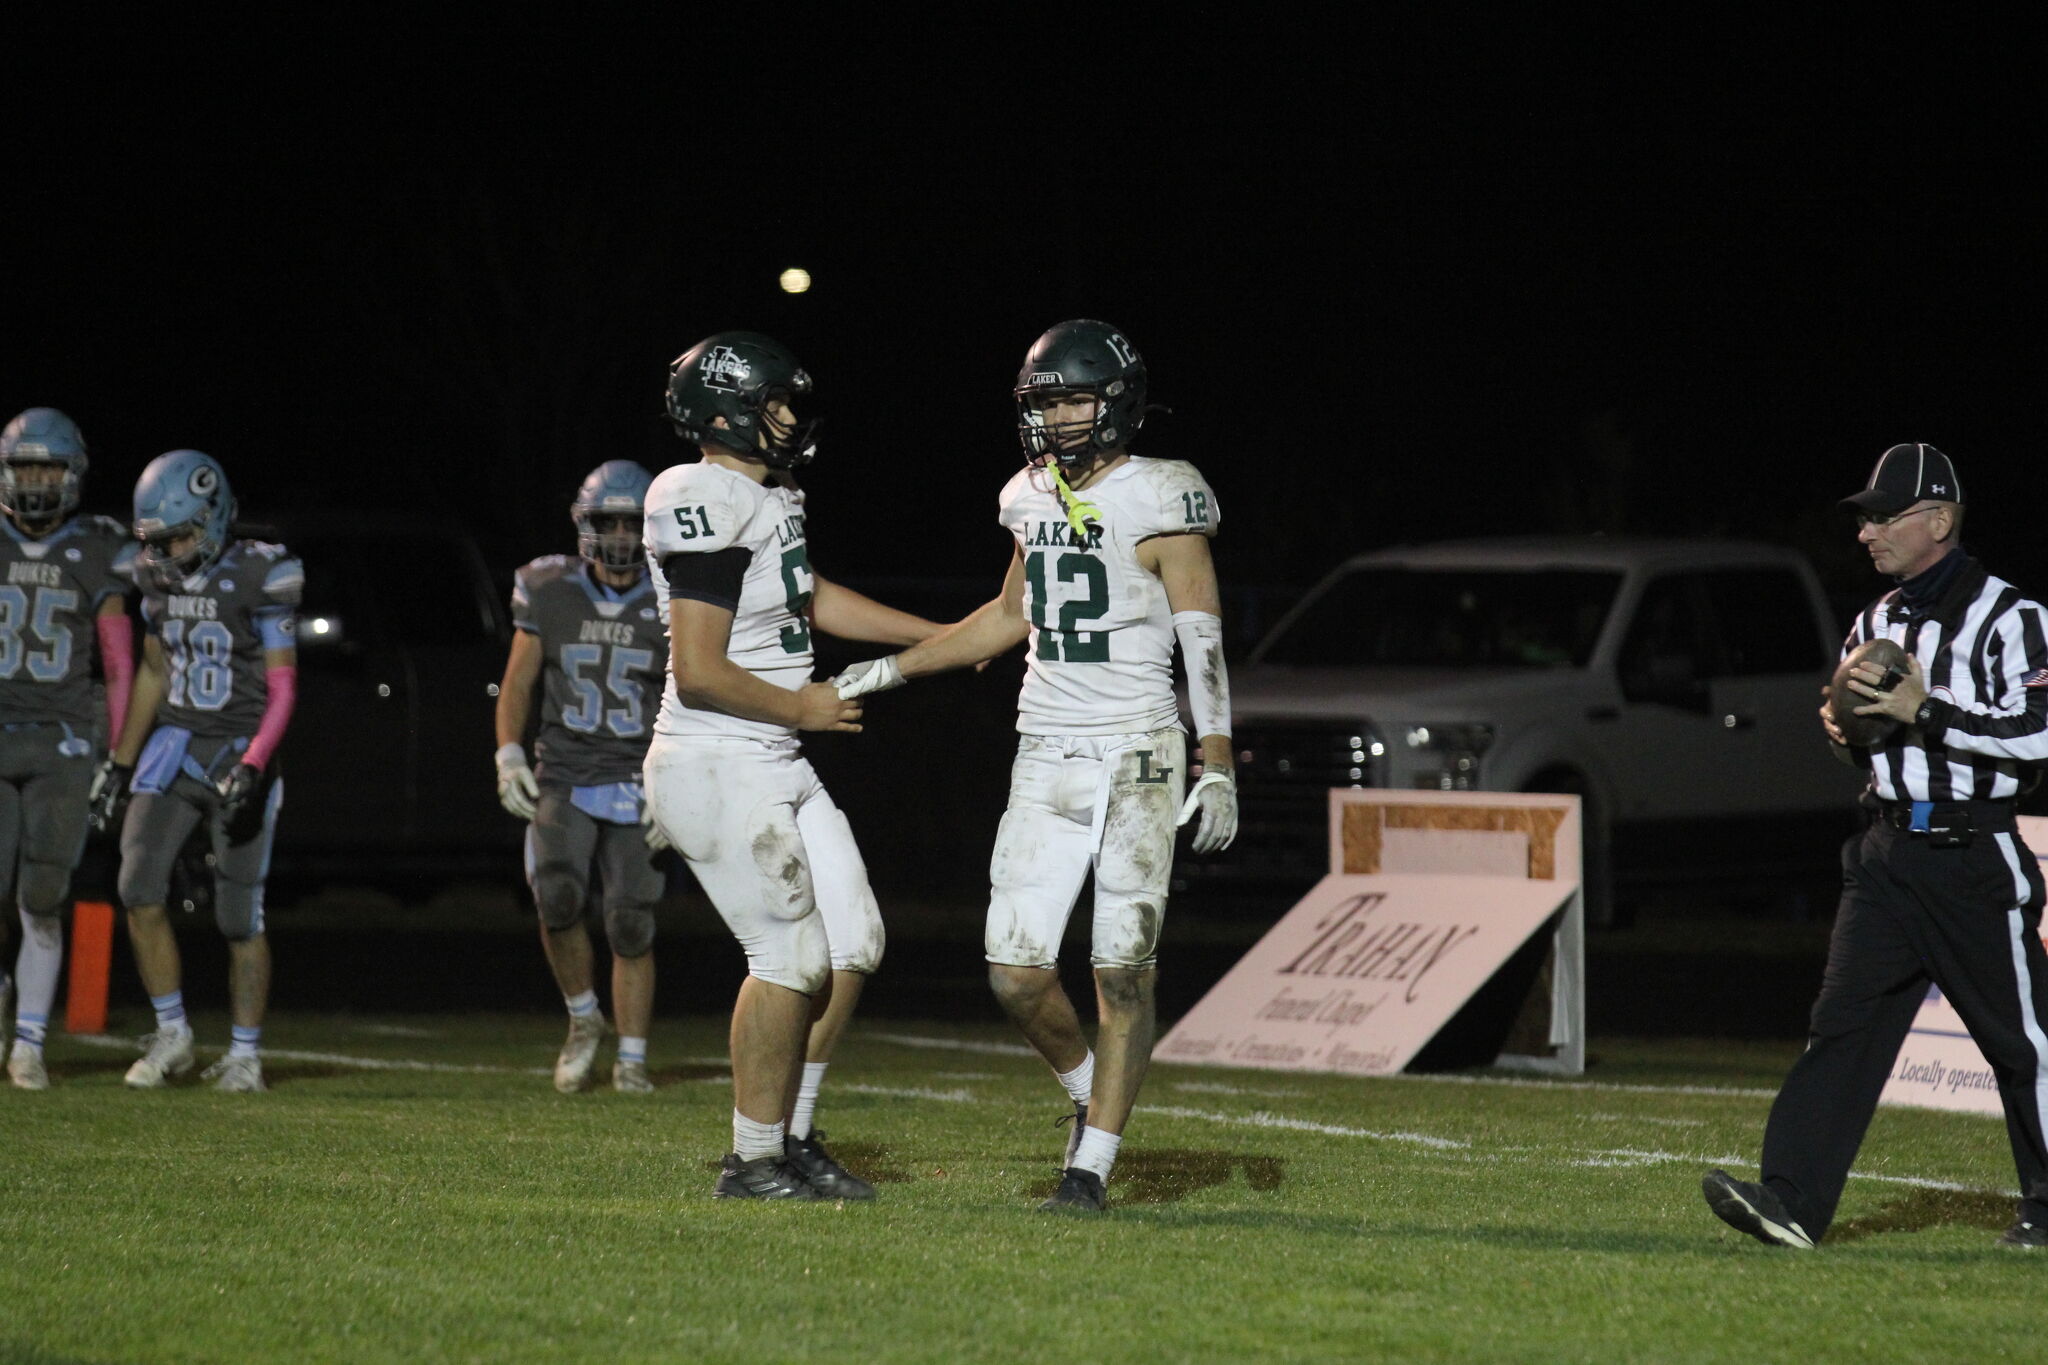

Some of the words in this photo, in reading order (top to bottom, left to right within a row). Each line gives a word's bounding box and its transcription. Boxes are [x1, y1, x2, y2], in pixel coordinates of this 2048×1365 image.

[699, 357, 752, 379] LAKERS
[1106, 334, 1137, 368] 12
[1031, 374, 1056, 384] LAKER
[673, 505, 716, 540] 51
[1182, 491, 1209, 524] 12
[780, 544, 813, 654] 5
[1025, 551, 1111, 663] 12
[162, 619, 234, 710] 18
[561, 644, 654, 737] 55
[1136, 750, 1174, 784] L
[1900, 1058, 1946, 1091] Locally
